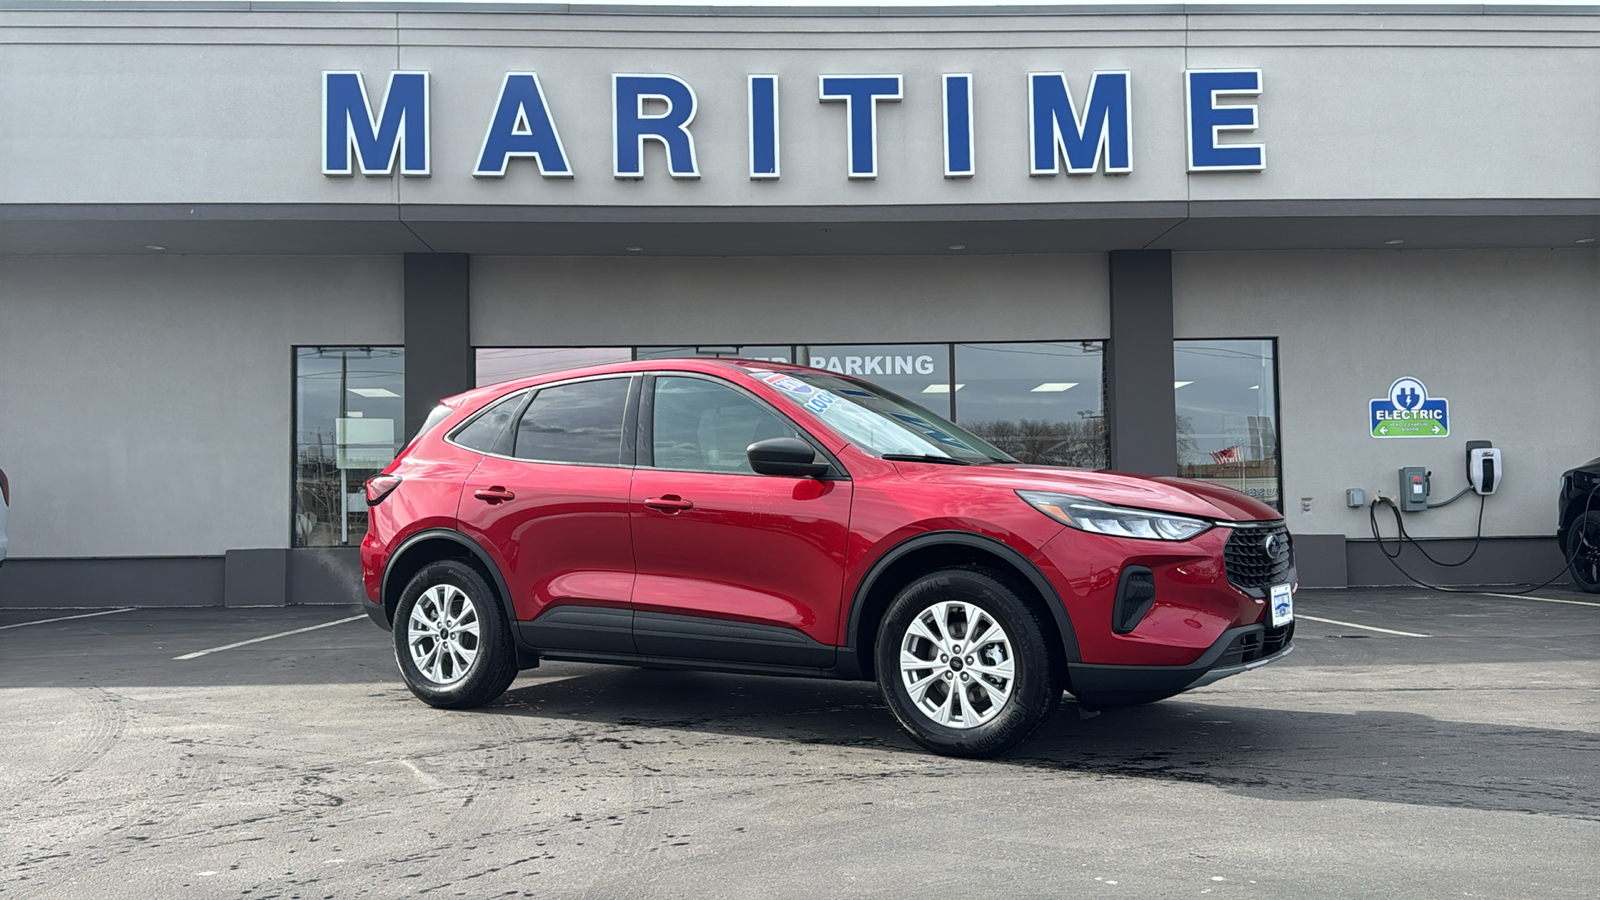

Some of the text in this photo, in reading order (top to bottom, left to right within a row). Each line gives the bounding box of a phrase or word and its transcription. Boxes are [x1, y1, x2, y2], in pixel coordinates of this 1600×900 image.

[322, 68, 1267, 180] MARITIME
[810, 355, 934, 375] PARKING
[1376, 409, 1443, 420] ELECTRIC
